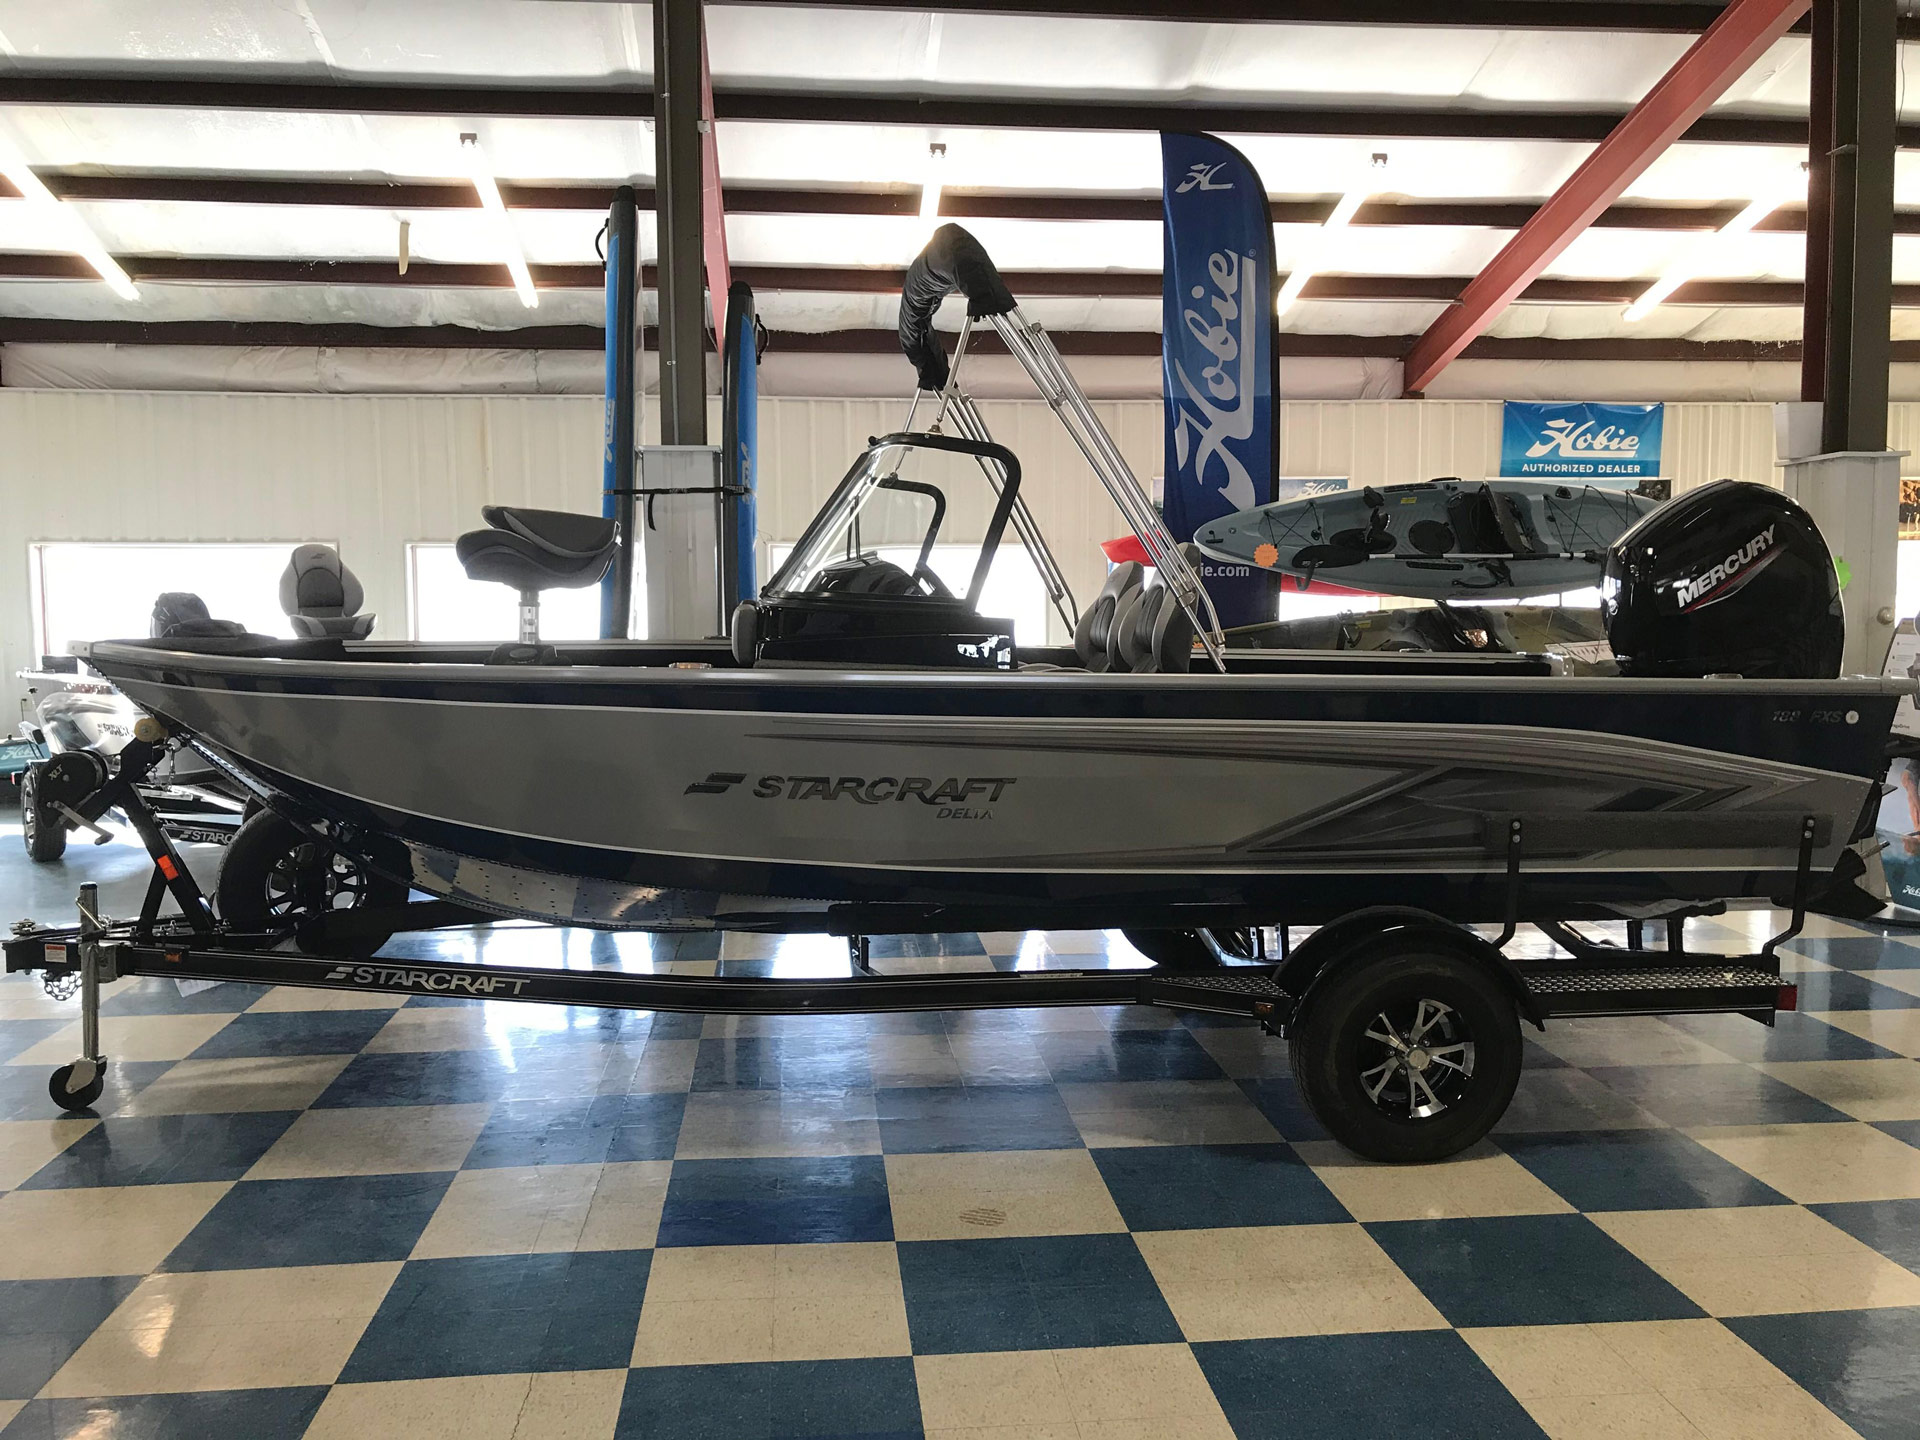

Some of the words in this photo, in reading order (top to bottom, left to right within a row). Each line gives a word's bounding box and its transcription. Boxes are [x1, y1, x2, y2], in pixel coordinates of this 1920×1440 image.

[1175, 249, 1256, 513] Hobie
[1525, 419, 1640, 458] Hobie
[1522, 463, 1594, 473] AUTHORIZED
[1598, 464, 1641, 473] DEALER
[1200, 563, 1250, 577] ie.com
[1677, 523, 1775, 608] MERCURY
[753, 775, 1017, 805] STARCRAFT
[191, 830, 236, 844] STARC
[353, 966, 531, 995] STARCRAFT
